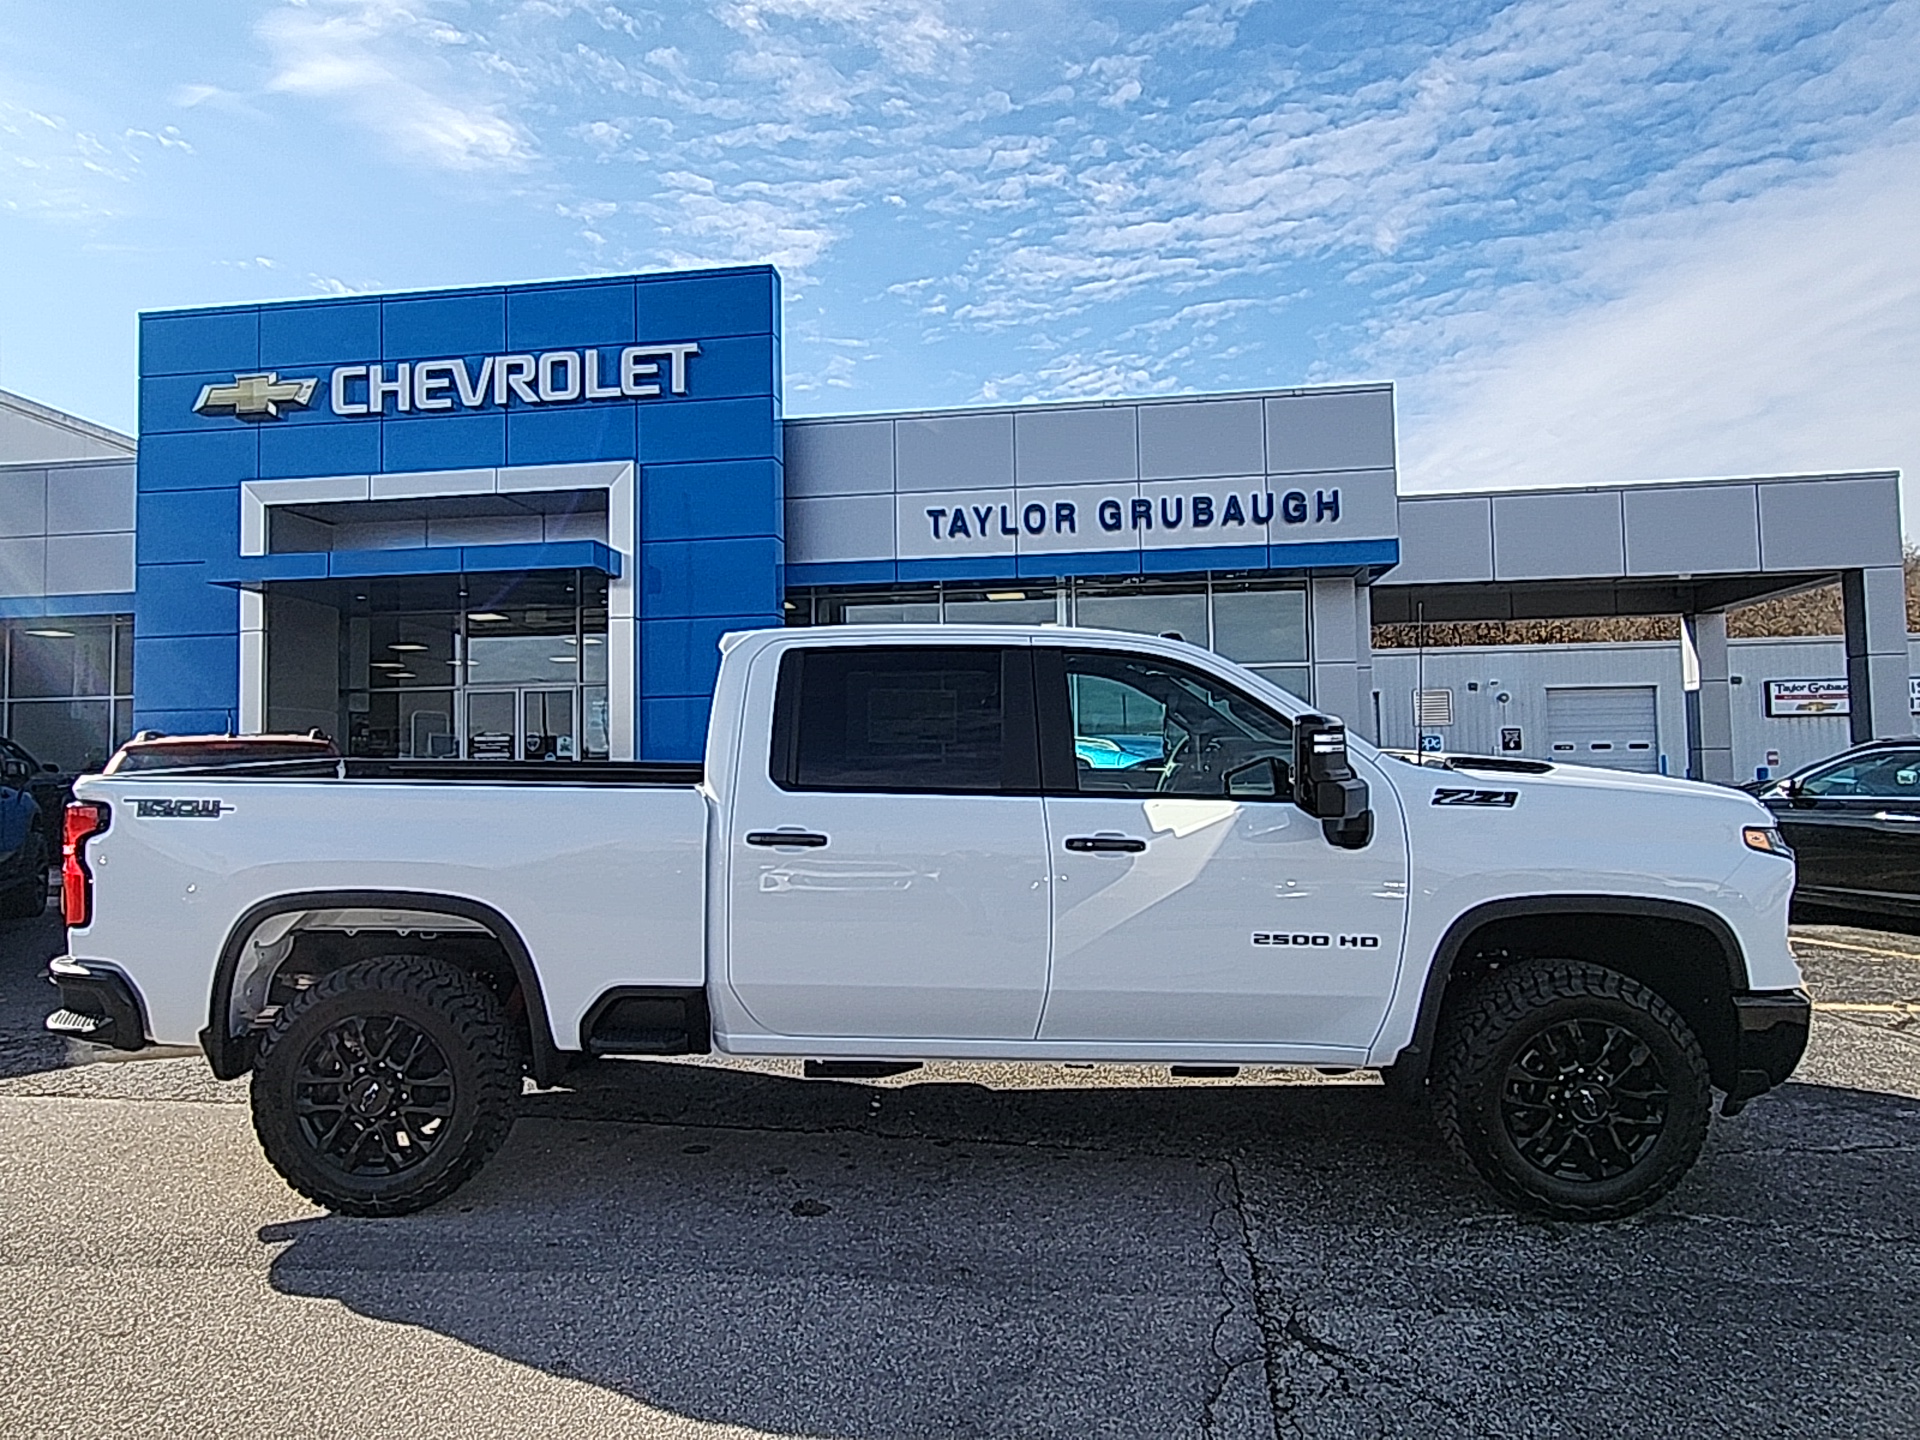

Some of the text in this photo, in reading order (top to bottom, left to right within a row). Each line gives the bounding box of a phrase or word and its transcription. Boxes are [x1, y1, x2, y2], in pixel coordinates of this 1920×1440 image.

[331, 342, 698, 416] CHEVROLET
[926, 489, 1341, 539] TAYLOR GRUBAUGH
[1775, 683, 1807, 694] Taylor
[1252, 933, 1379, 948] 2500 HD
